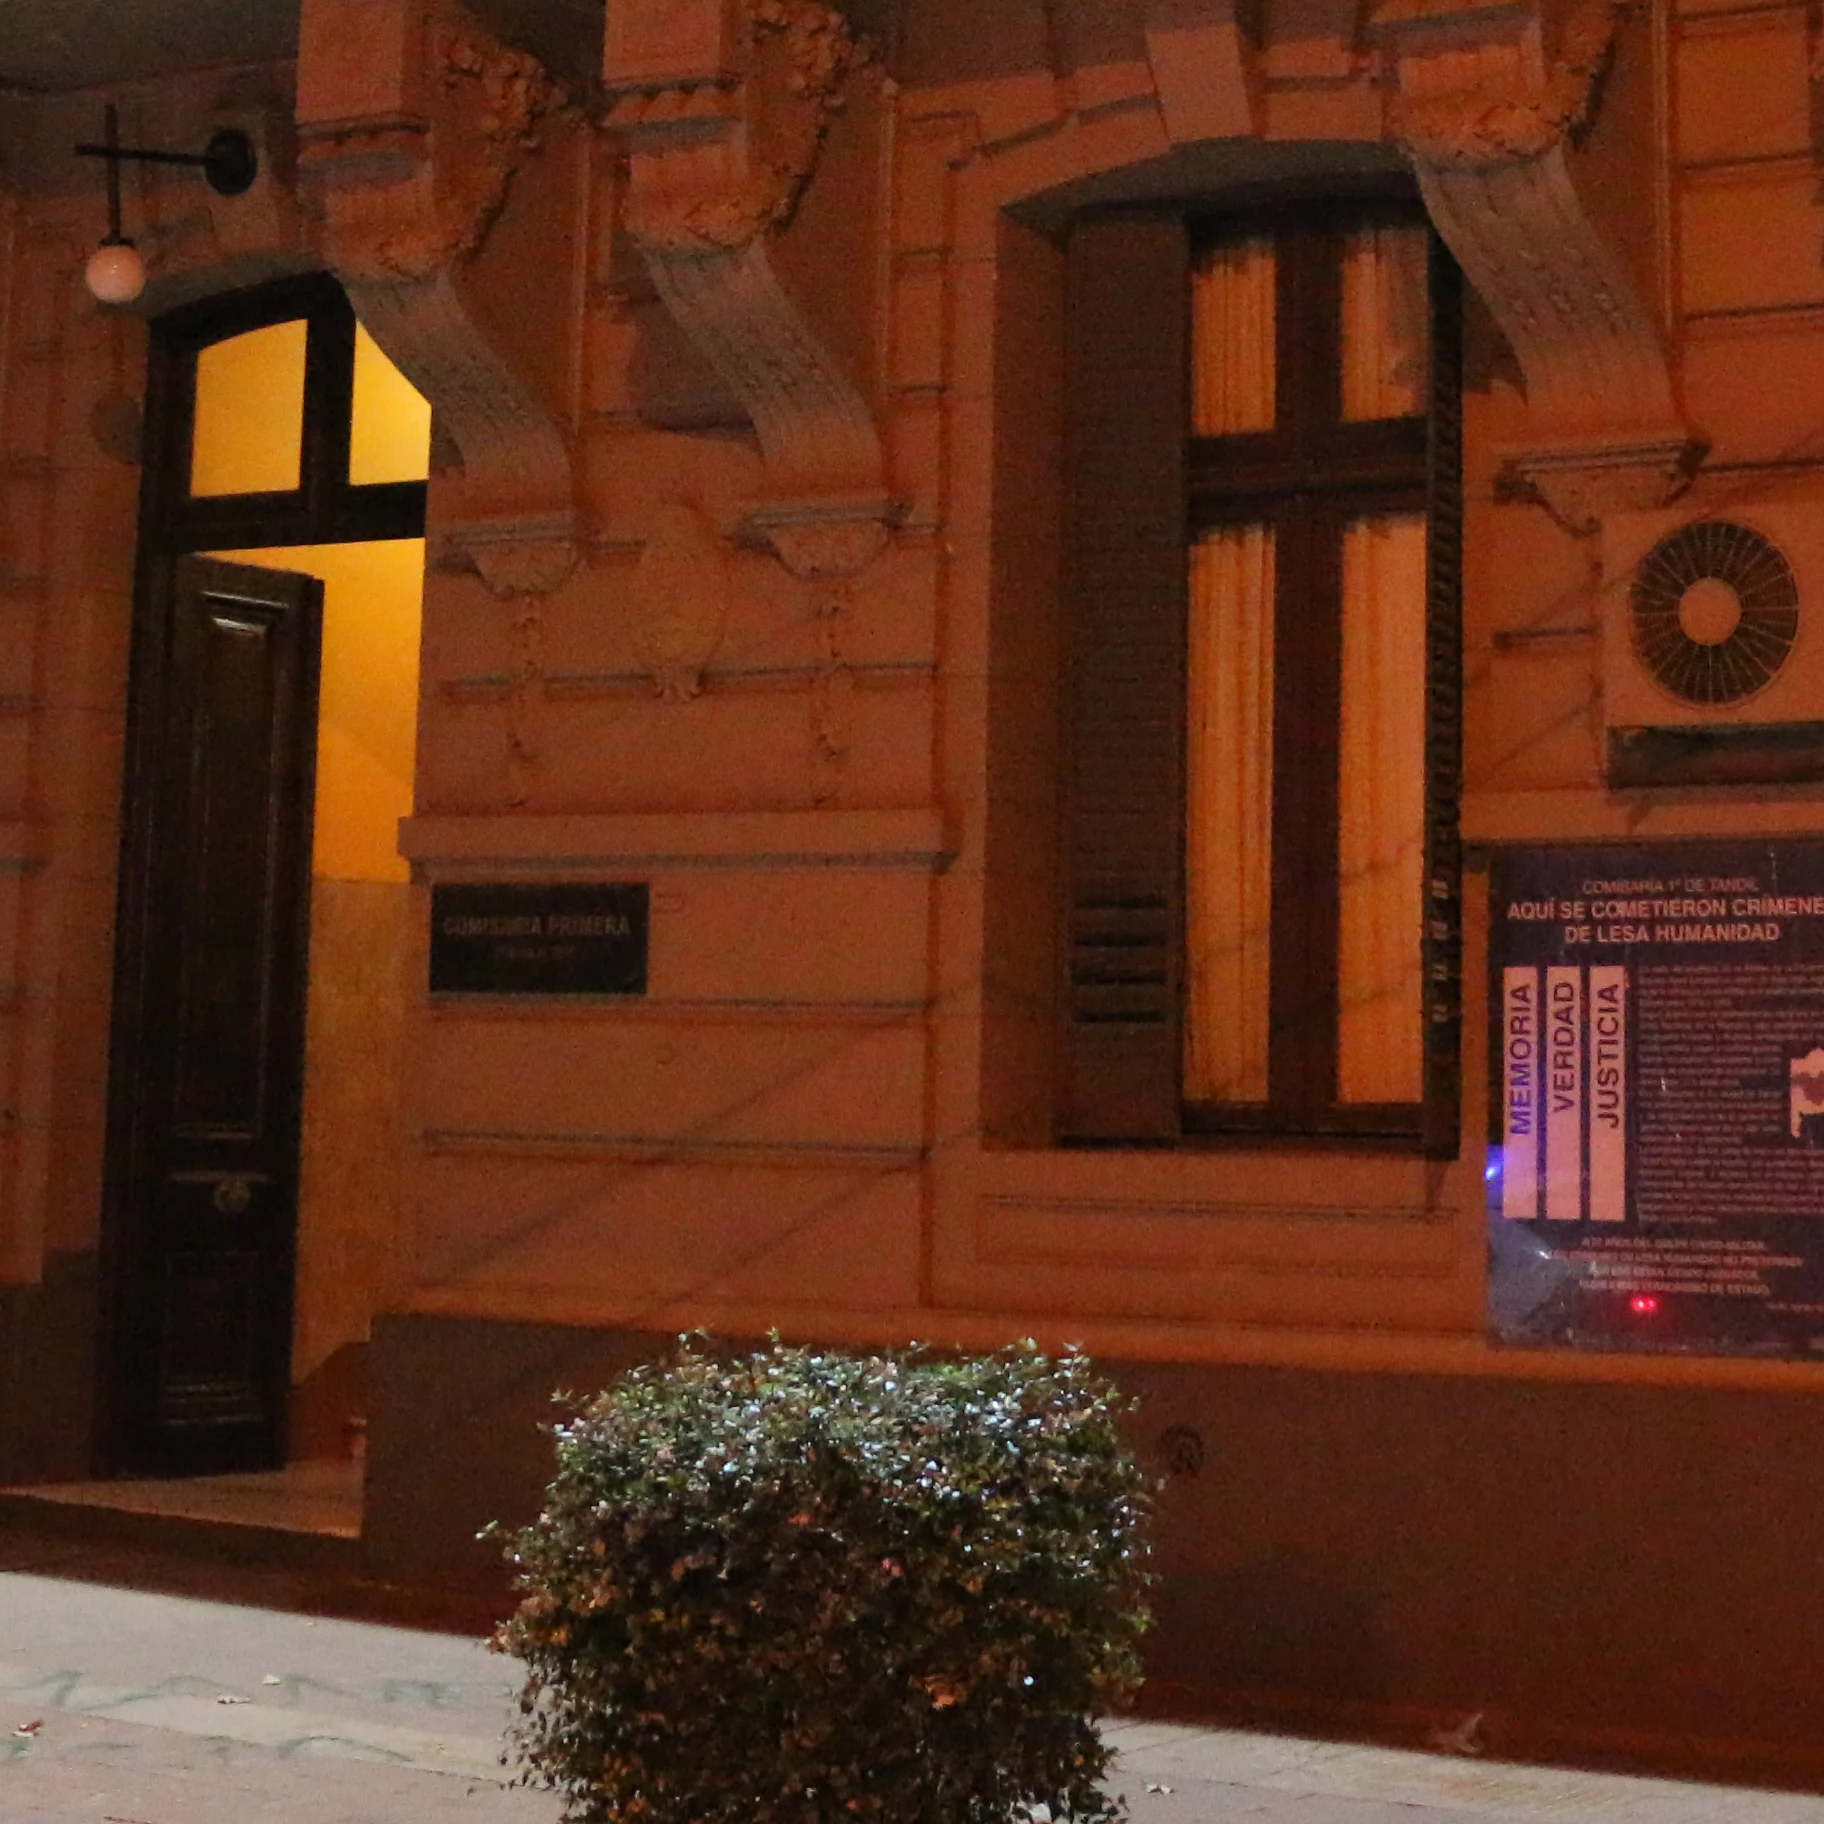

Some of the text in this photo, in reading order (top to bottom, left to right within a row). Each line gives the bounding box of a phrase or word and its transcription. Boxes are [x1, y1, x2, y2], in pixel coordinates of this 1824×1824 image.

[1507, 897, 1555, 920] AQUÍ
[1559, 901, 1586, 919] SE
[1590, 898, 1726, 919] COMETIERON
[1564, 923, 1780, 944] DE LESA HUMANIDAD
[1509, 984, 1532, 1135] MEMORIA
[1553, 981, 1574, 1113] VERDAD
[1597, 983, 1619, 1129] JUSTICIA
